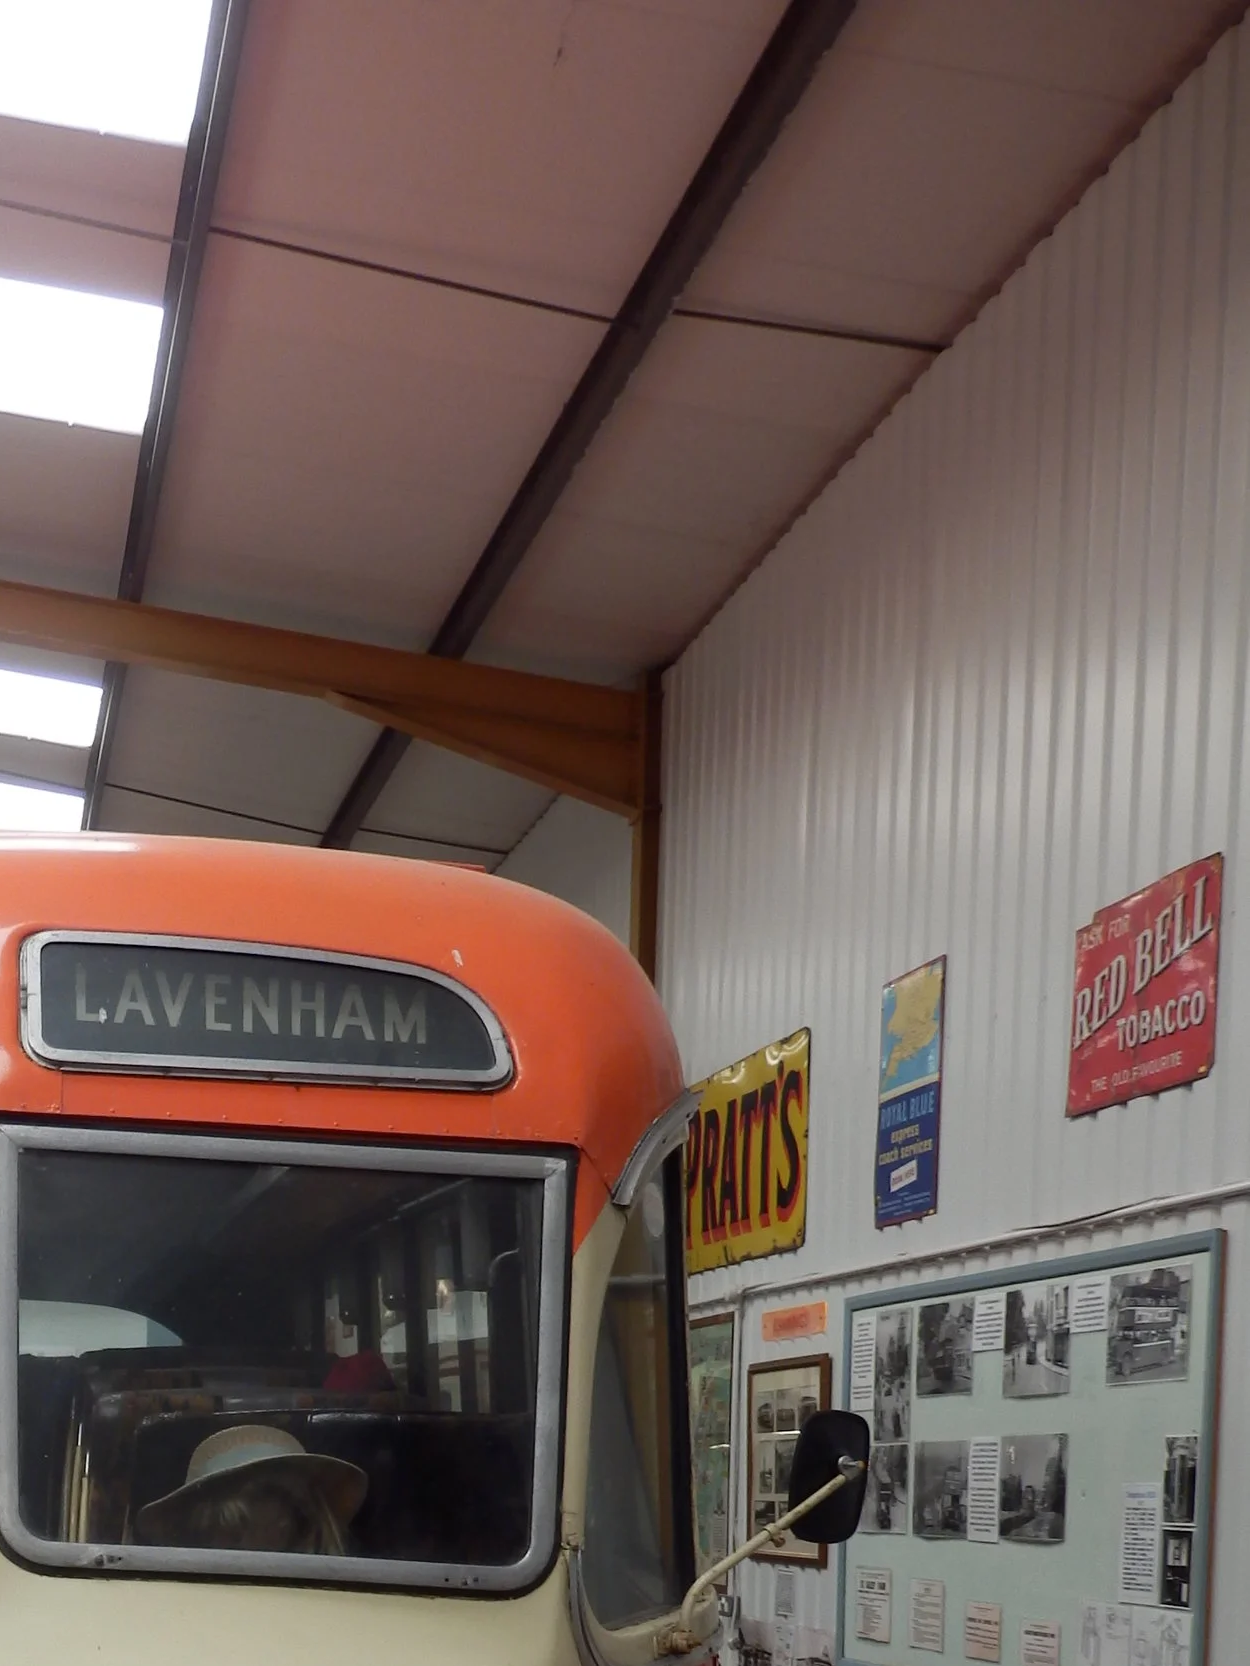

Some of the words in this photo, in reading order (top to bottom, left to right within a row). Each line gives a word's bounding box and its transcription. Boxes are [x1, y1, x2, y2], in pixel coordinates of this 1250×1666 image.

[1073, 954, 1129, 1049] RED
[1133, 876, 1213, 995] BELL
[74, 963, 428, 1045] LAVENHAM
[1116, 990, 1207, 1051] TOBACCO
[881, 1101, 907, 1130] ROYAL
[909, 1090, 935, 1120] BLUE
